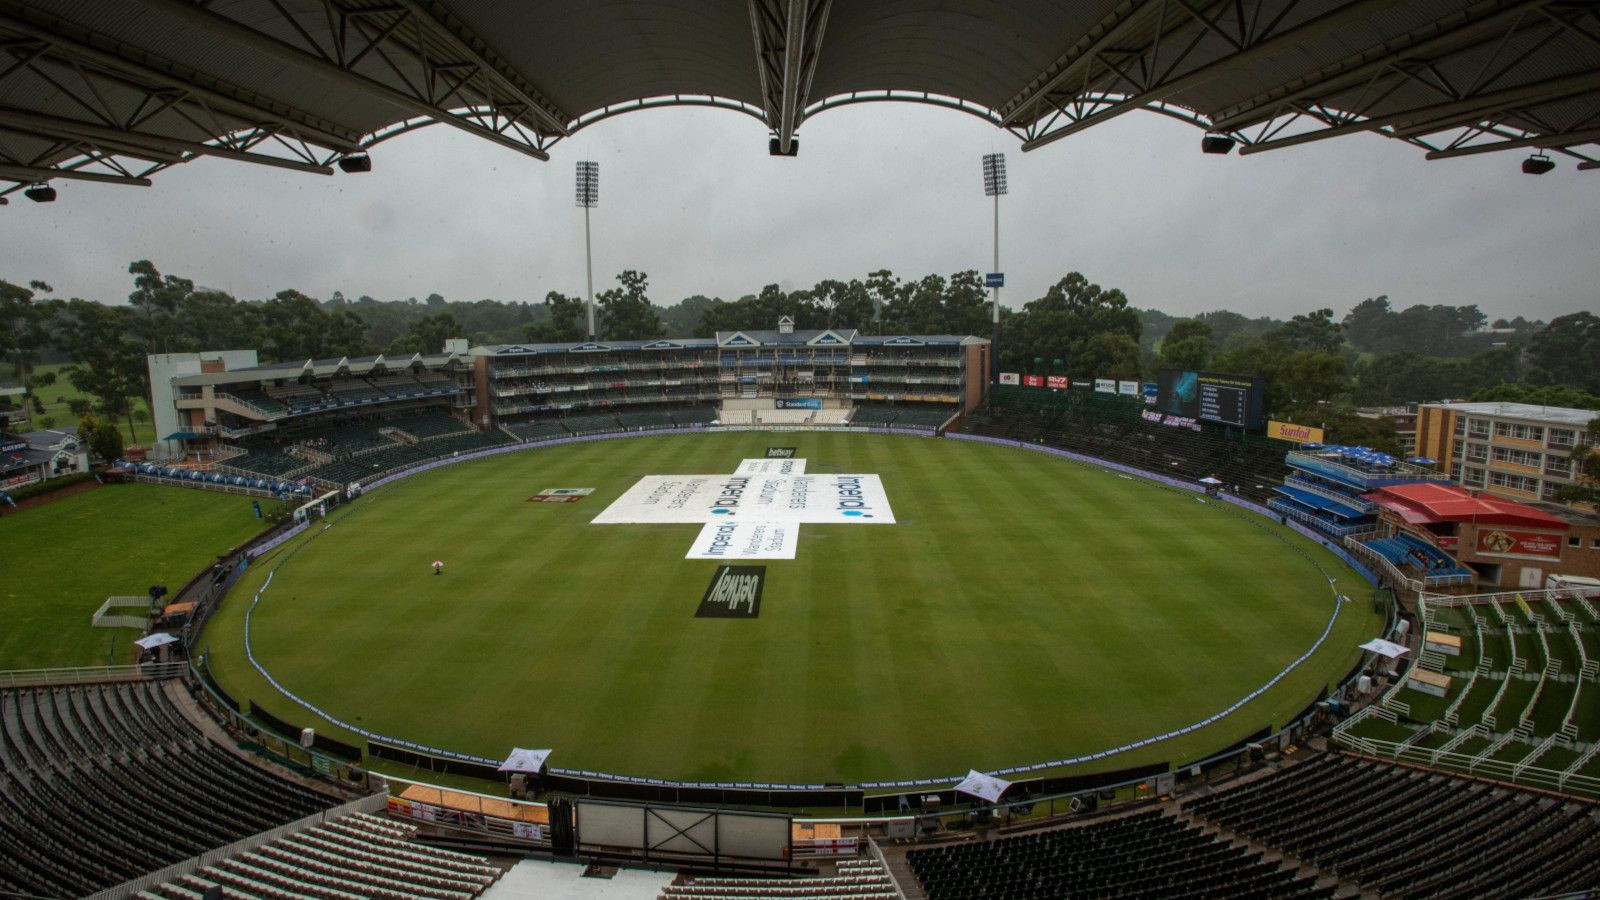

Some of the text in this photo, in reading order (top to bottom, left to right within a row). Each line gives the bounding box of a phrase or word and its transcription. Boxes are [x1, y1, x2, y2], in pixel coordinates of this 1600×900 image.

[1280, 424, 1311, 440] Sunfoil
[768, 447, 794, 457] betway
[836, 476, 872, 510] Imperial
[702, 524, 739, 555] Imperial
[707, 566, 759, 614] betway
